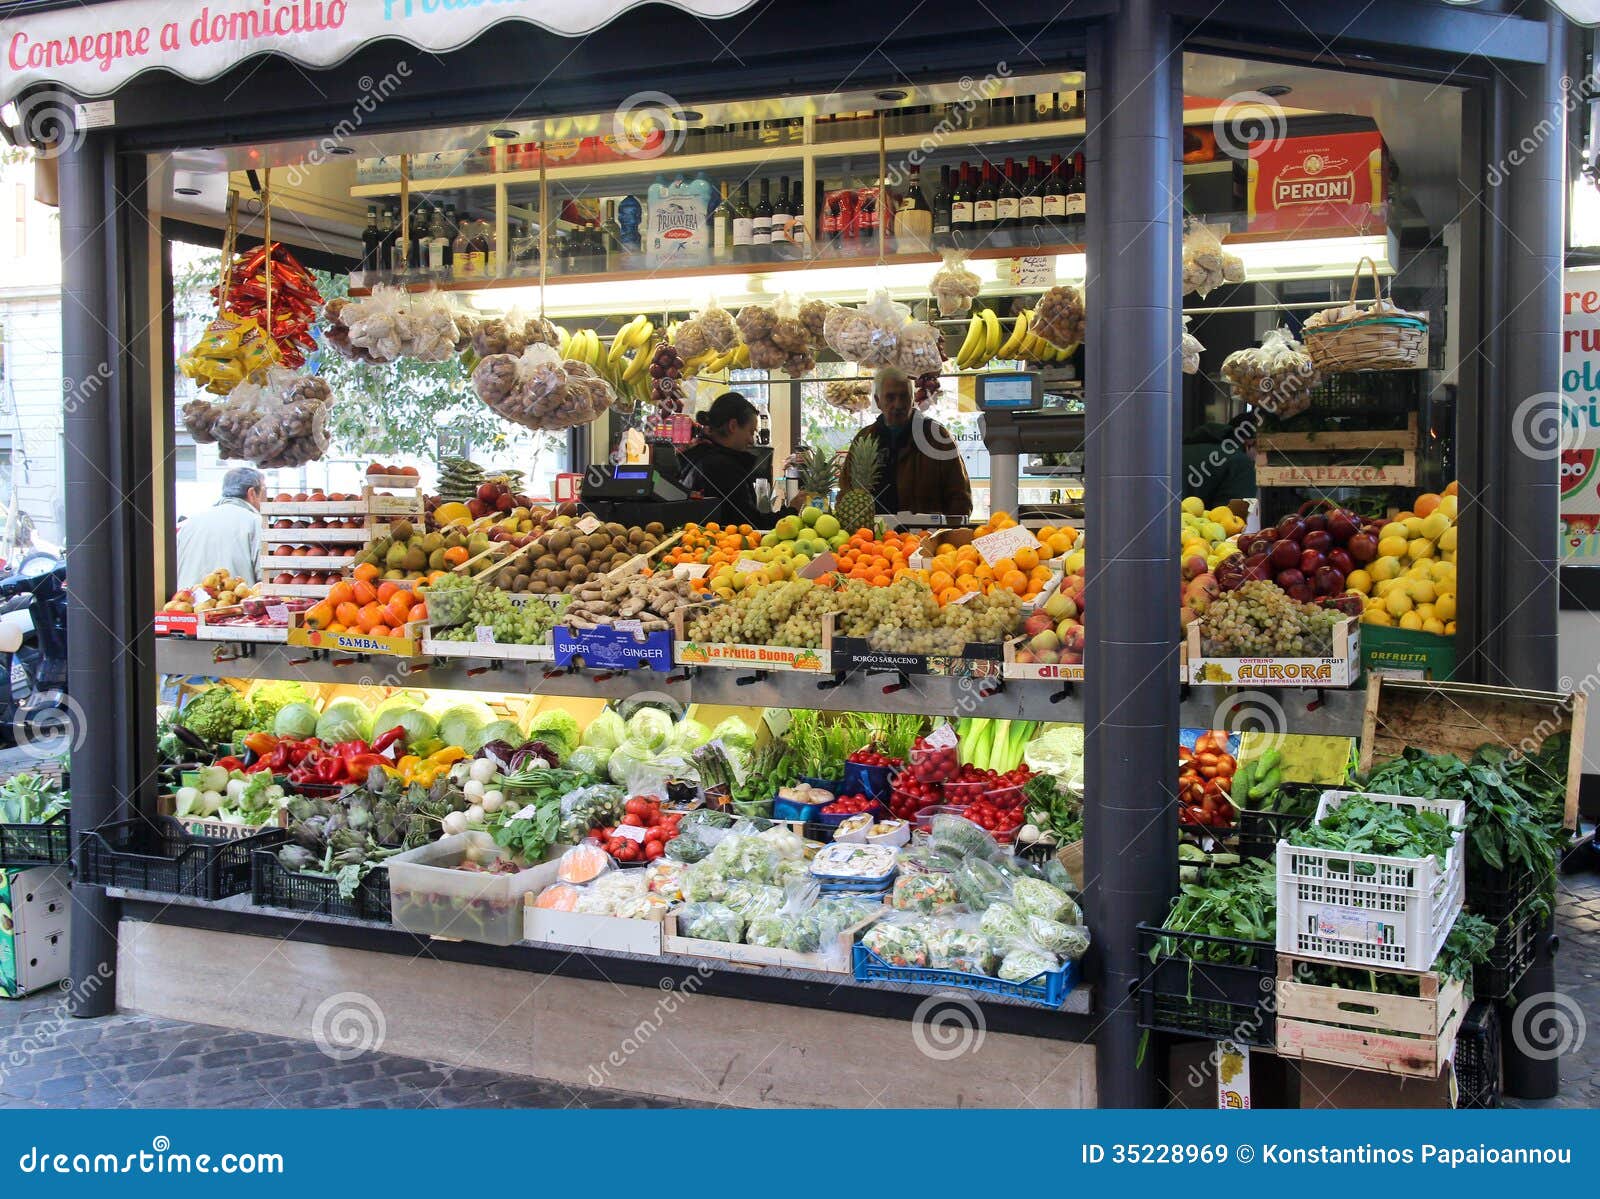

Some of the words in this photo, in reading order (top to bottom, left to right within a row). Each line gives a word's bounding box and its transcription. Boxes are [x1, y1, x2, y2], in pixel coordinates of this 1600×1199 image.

[8, 27, 150, 72] Consegne
[160, 22, 180, 51] a
[190, 0, 347, 47] domicilio
[1279, 181, 1348, 200] PERONI
[657, 213, 698, 231] PRIMAVERA
[1562, 329, 1600, 353] ru
[338, 637, 379, 649] SAMBA
[559, 643, 590, 654] SUPER
[622, 647, 663, 658] GINGER
[706, 646, 720, 657] La
[722, 647, 756, 660] Frutta
[758, 649, 794, 662] Buona
[852, 655, 878, 663] BORGO
[879, 656, 918, 665] SARACENO
[1370, 651, 1427, 662] ORFRUTTA
[1237, 663, 1332, 679] AURORA
